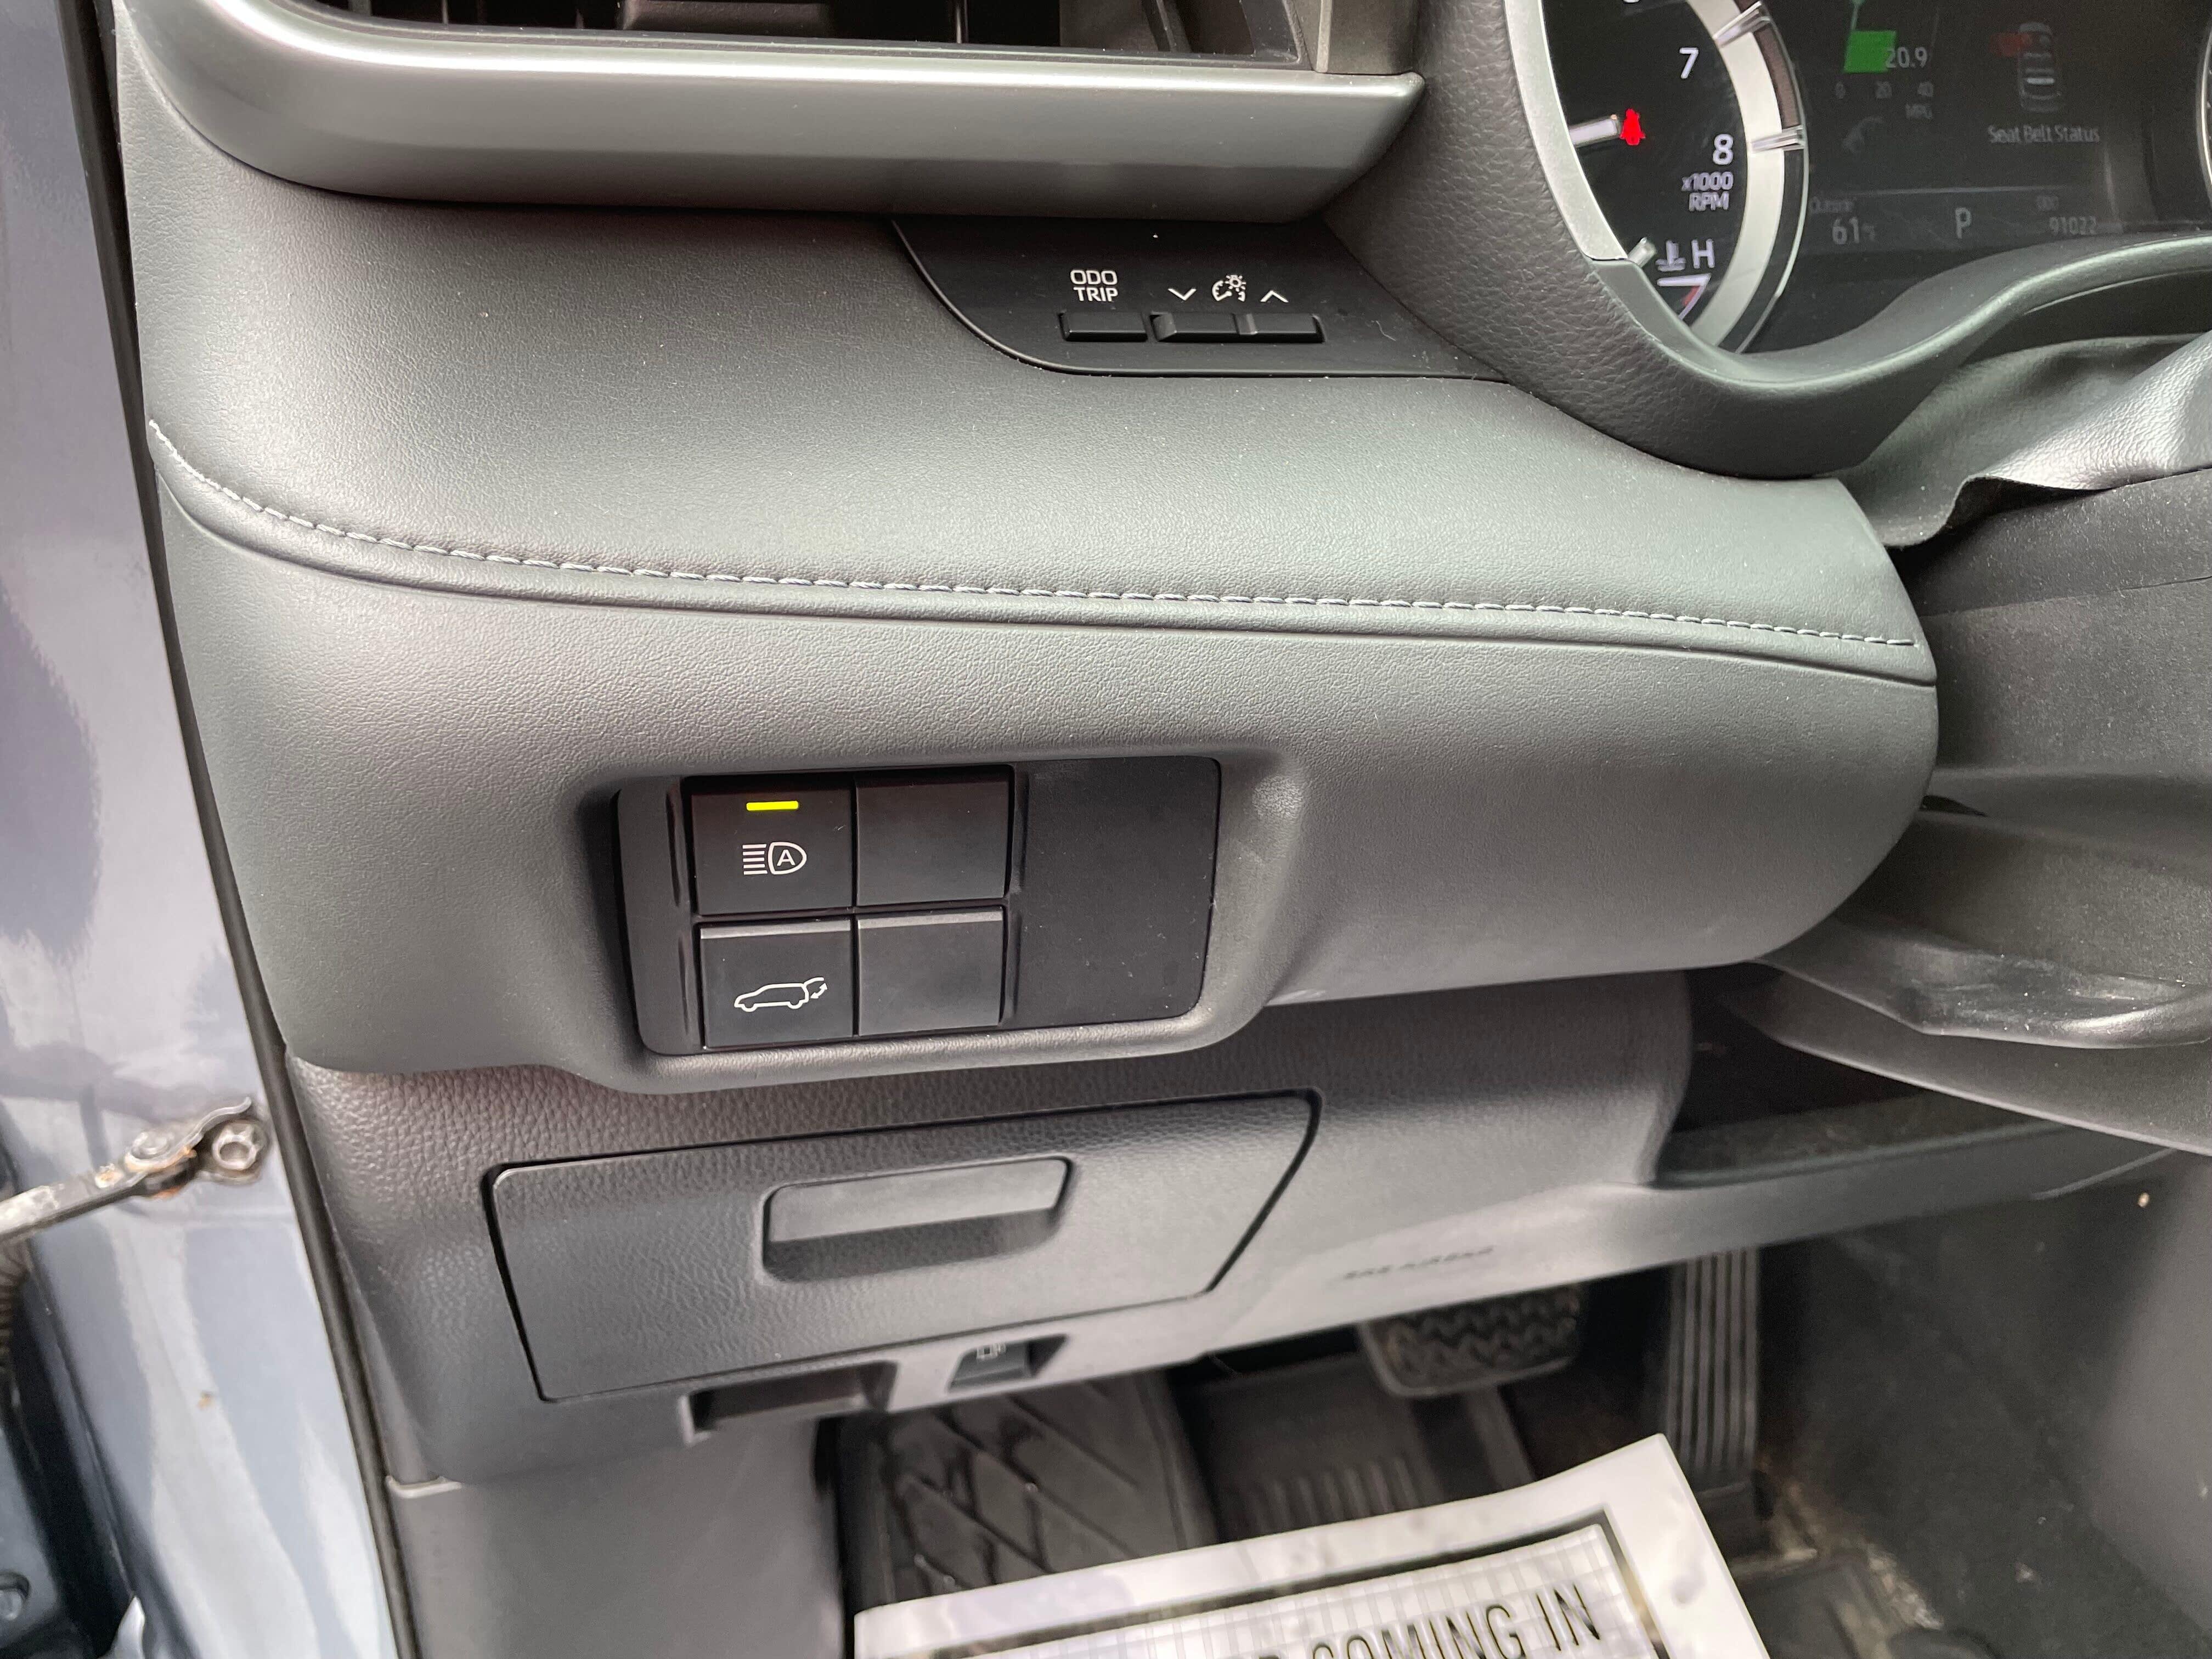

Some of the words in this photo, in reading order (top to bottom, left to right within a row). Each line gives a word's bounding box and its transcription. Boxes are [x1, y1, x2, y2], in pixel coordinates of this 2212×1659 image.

[1679, 47, 1699, 78] 7
[1885, 47, 1928, 69] 20.9
[1988, 125, 2019, 143] Seat
[2023, 124, 2052, 143] Belt
[2055, 124, 2100, 143] Status
[1713, 134, 1733, 165] 8
[1689, 192, 1729, 211] RPM
[1955, 207, 1972, 239] P
[1691, 239, 1715, 268] H
[1070, 270, 1118, 286] ODO
[1073, 287, 1119, 302] TRIP
[777, 849, 795, 866] A
[1312, 1603, 1526, 1659] MING
[1535, 1583, 1601, 1651] IN
